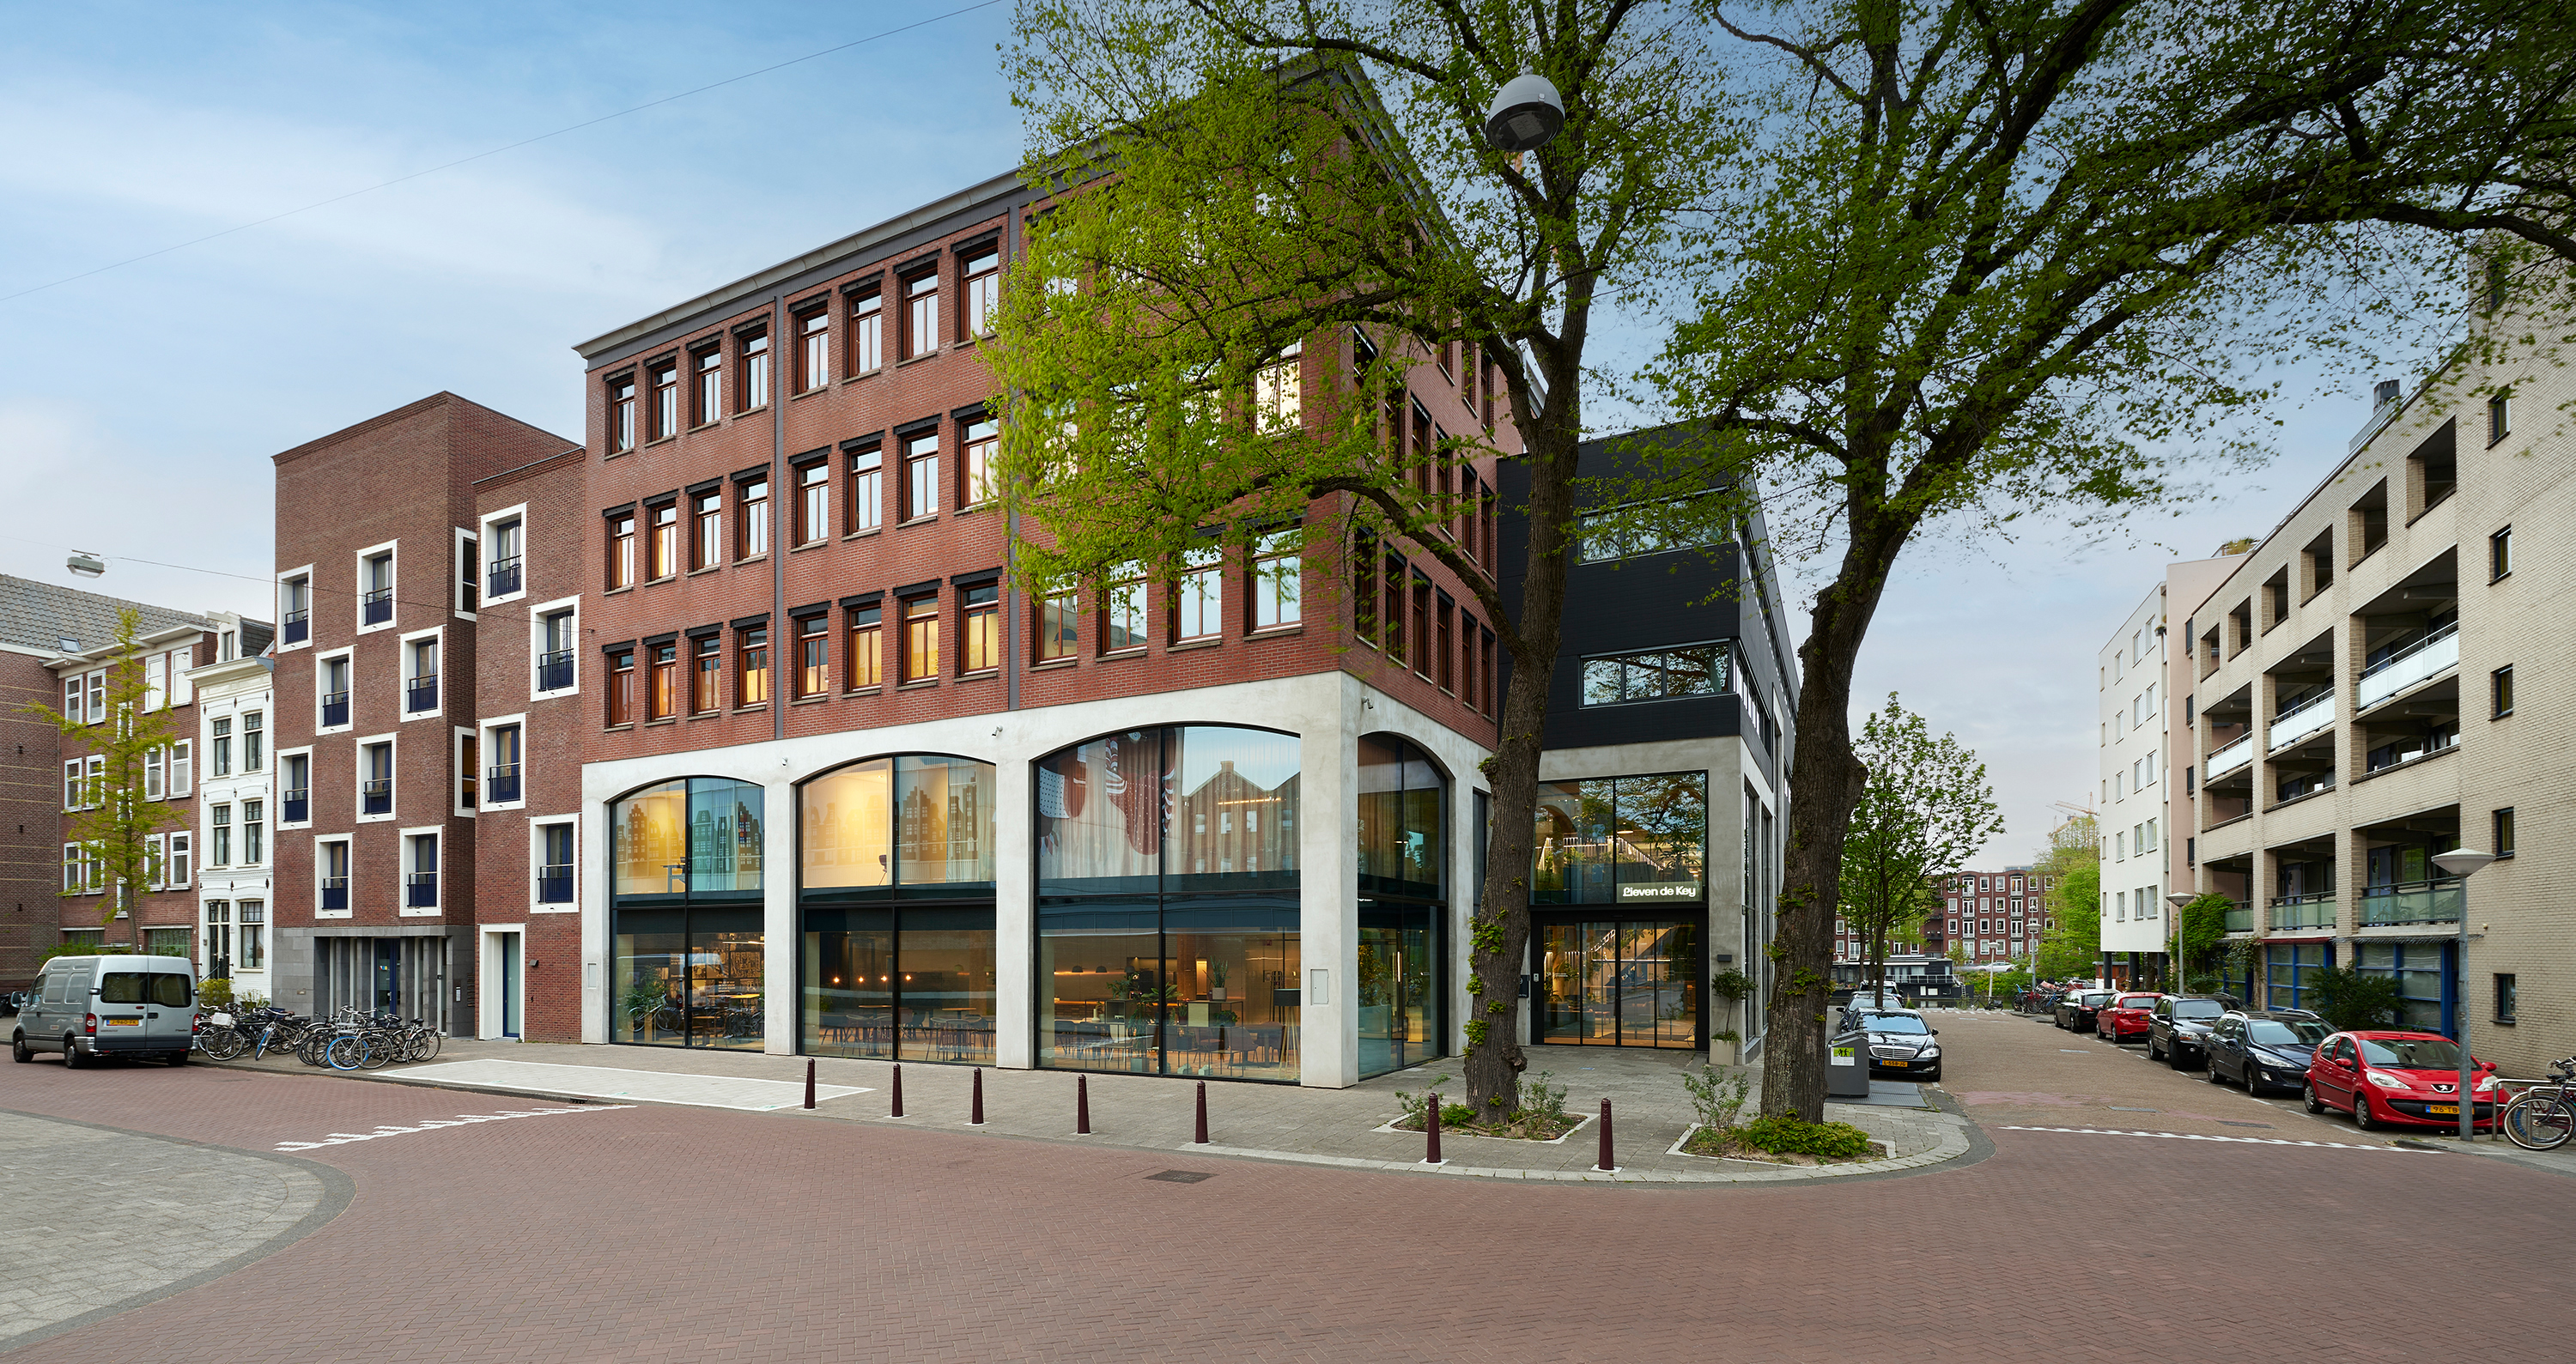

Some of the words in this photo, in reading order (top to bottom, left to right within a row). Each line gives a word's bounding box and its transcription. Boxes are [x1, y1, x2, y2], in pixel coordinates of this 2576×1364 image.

[1623, 887, 1658, 896] Lieven
[1659, 886, 1674, 895] de
[1675, 886, 1696, 897] Key
